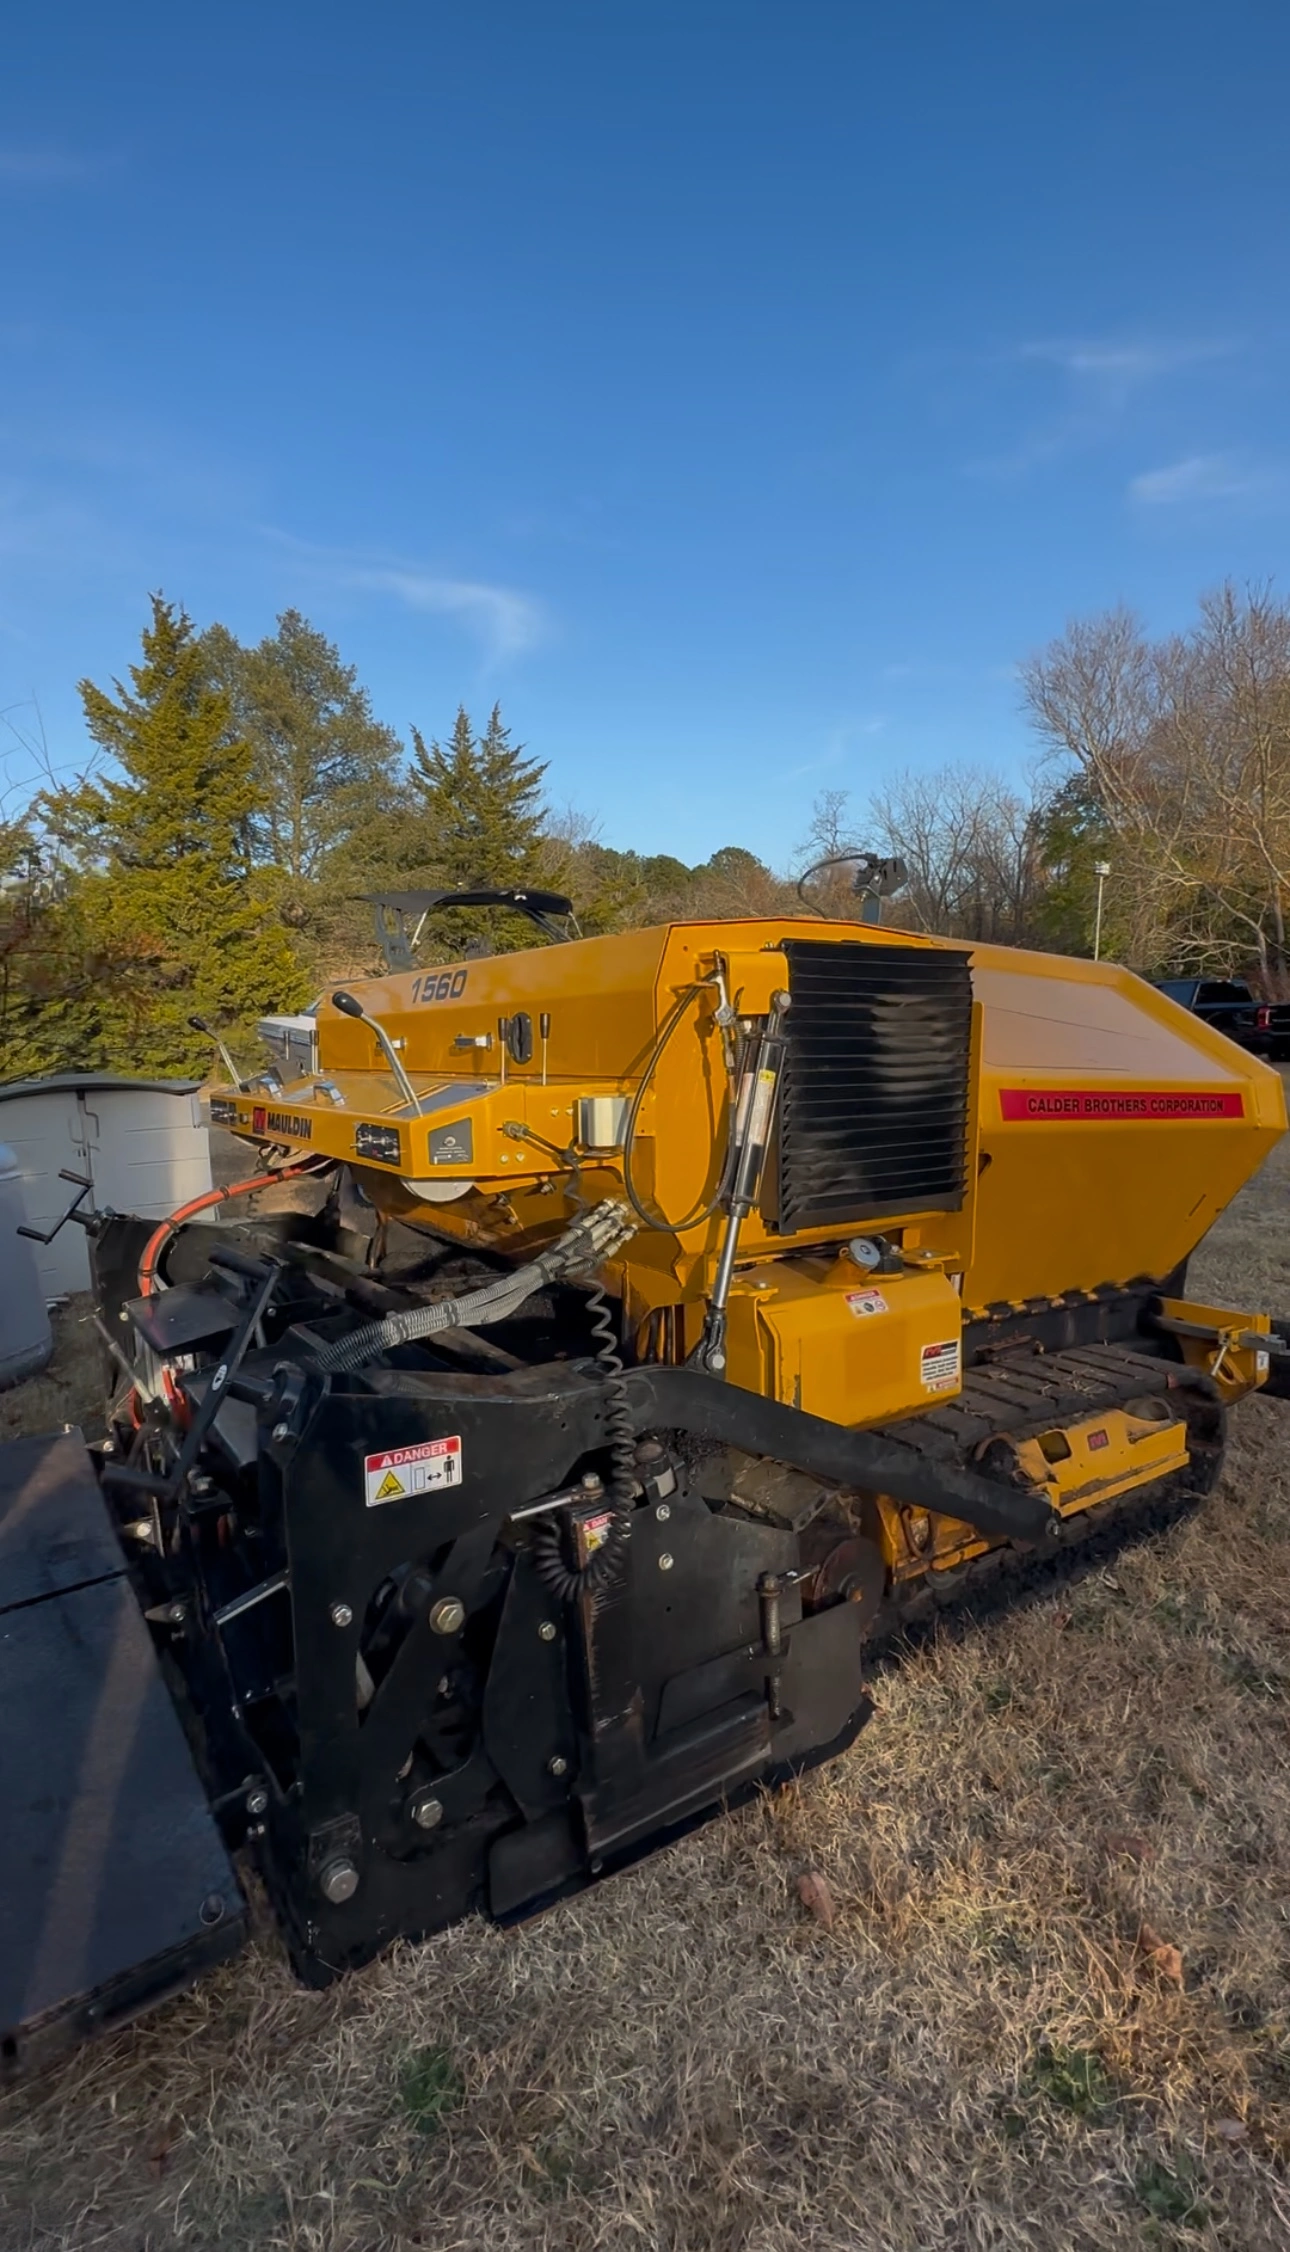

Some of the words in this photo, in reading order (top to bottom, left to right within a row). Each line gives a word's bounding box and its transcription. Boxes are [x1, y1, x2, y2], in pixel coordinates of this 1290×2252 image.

[412, 969, 468, 1004] 1560
[1028, 1098, 1080, 1113] CALDER
[1084, 1099, 1147, 1112] BROTHERS
[1150, 1100, 1224, 1112] CORPORATION
[267, 1111, 313, 1140] MAULDIN
[394, 1442, 448, 1464] DANGER
